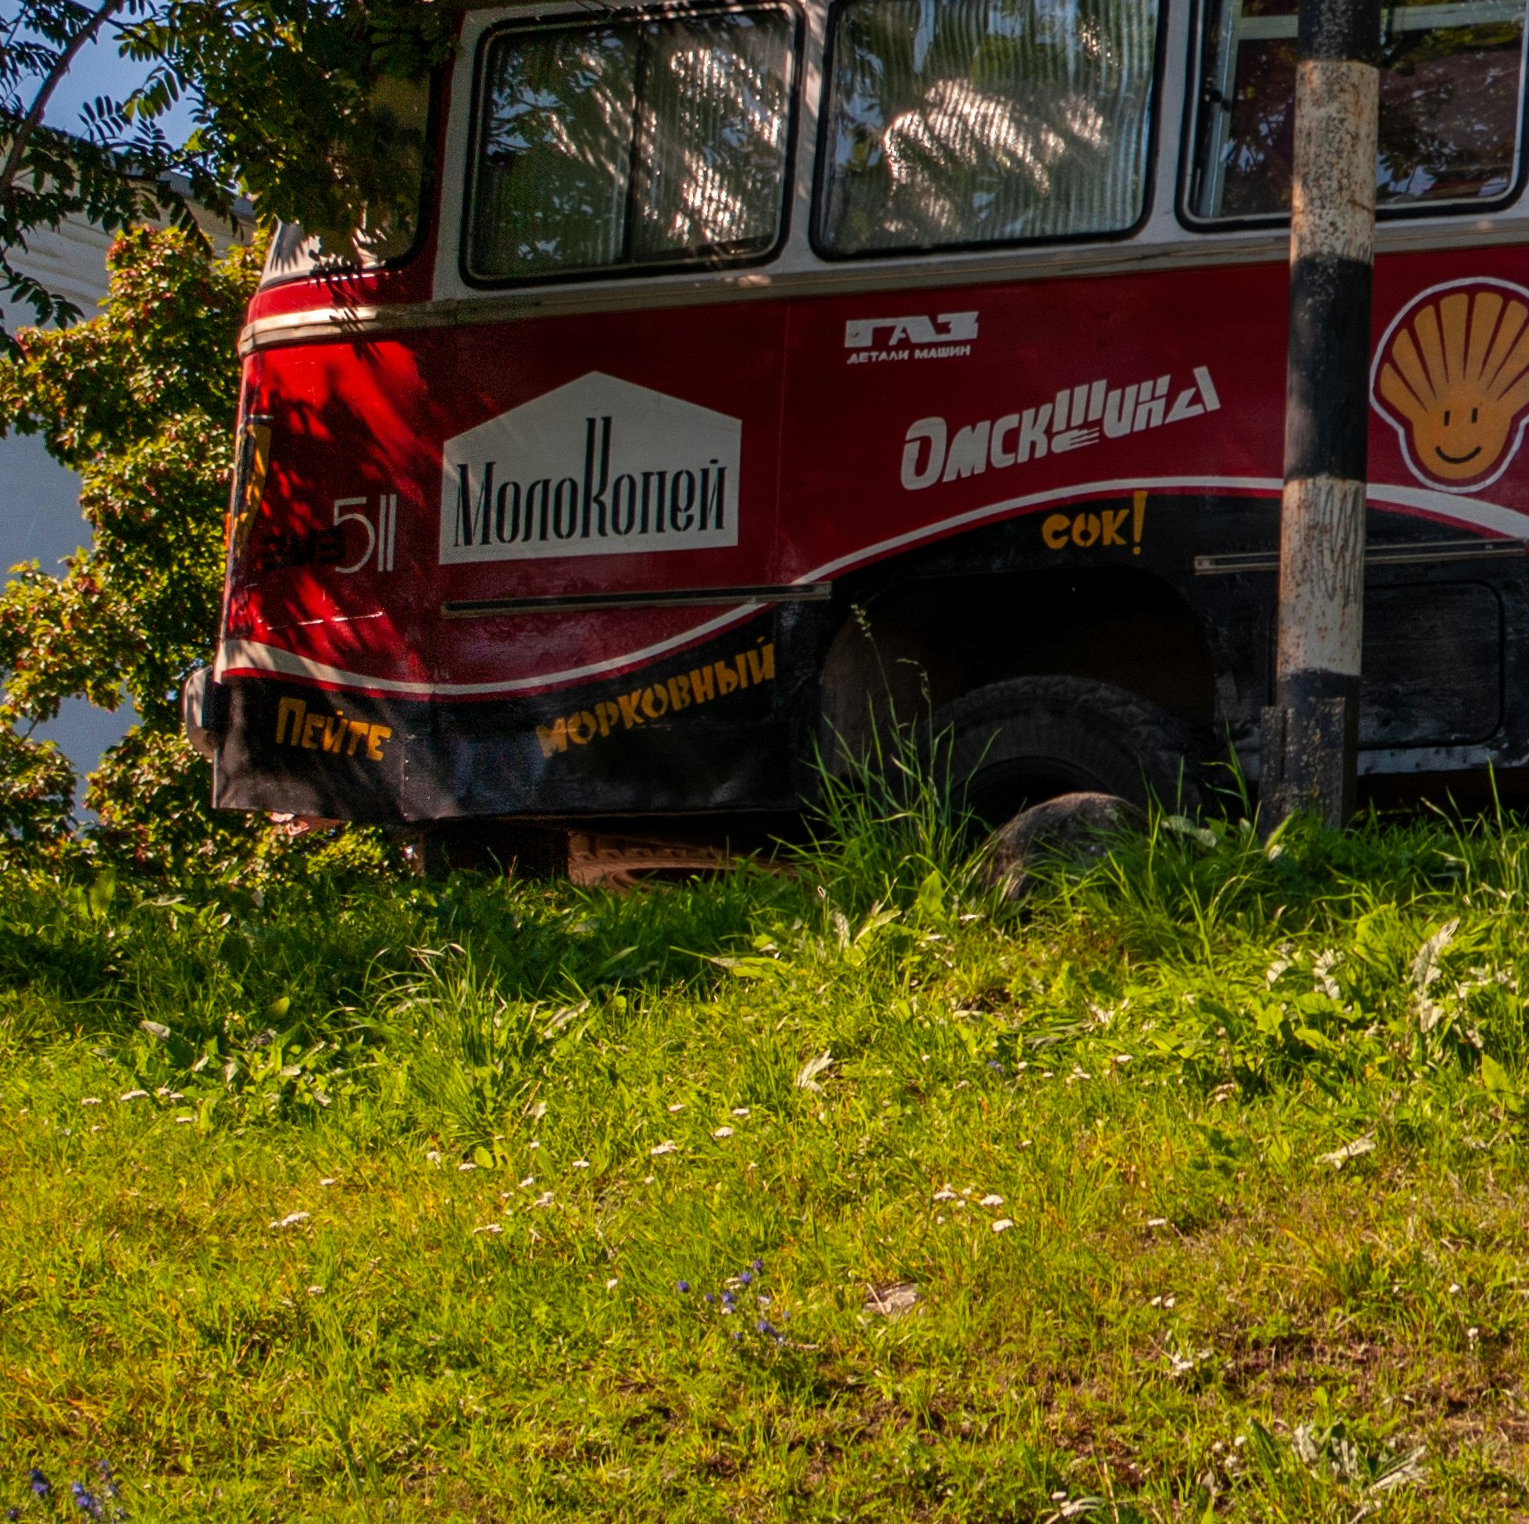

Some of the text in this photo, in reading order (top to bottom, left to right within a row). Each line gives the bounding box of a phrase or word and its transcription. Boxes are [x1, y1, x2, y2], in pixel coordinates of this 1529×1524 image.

[844, 311, 979, 348] ГАЗ
[846, 345, 971, 365] ДЕТАЛИ МАШИН
[534, 638, 776, 760] МОРКОВНЫЙ
